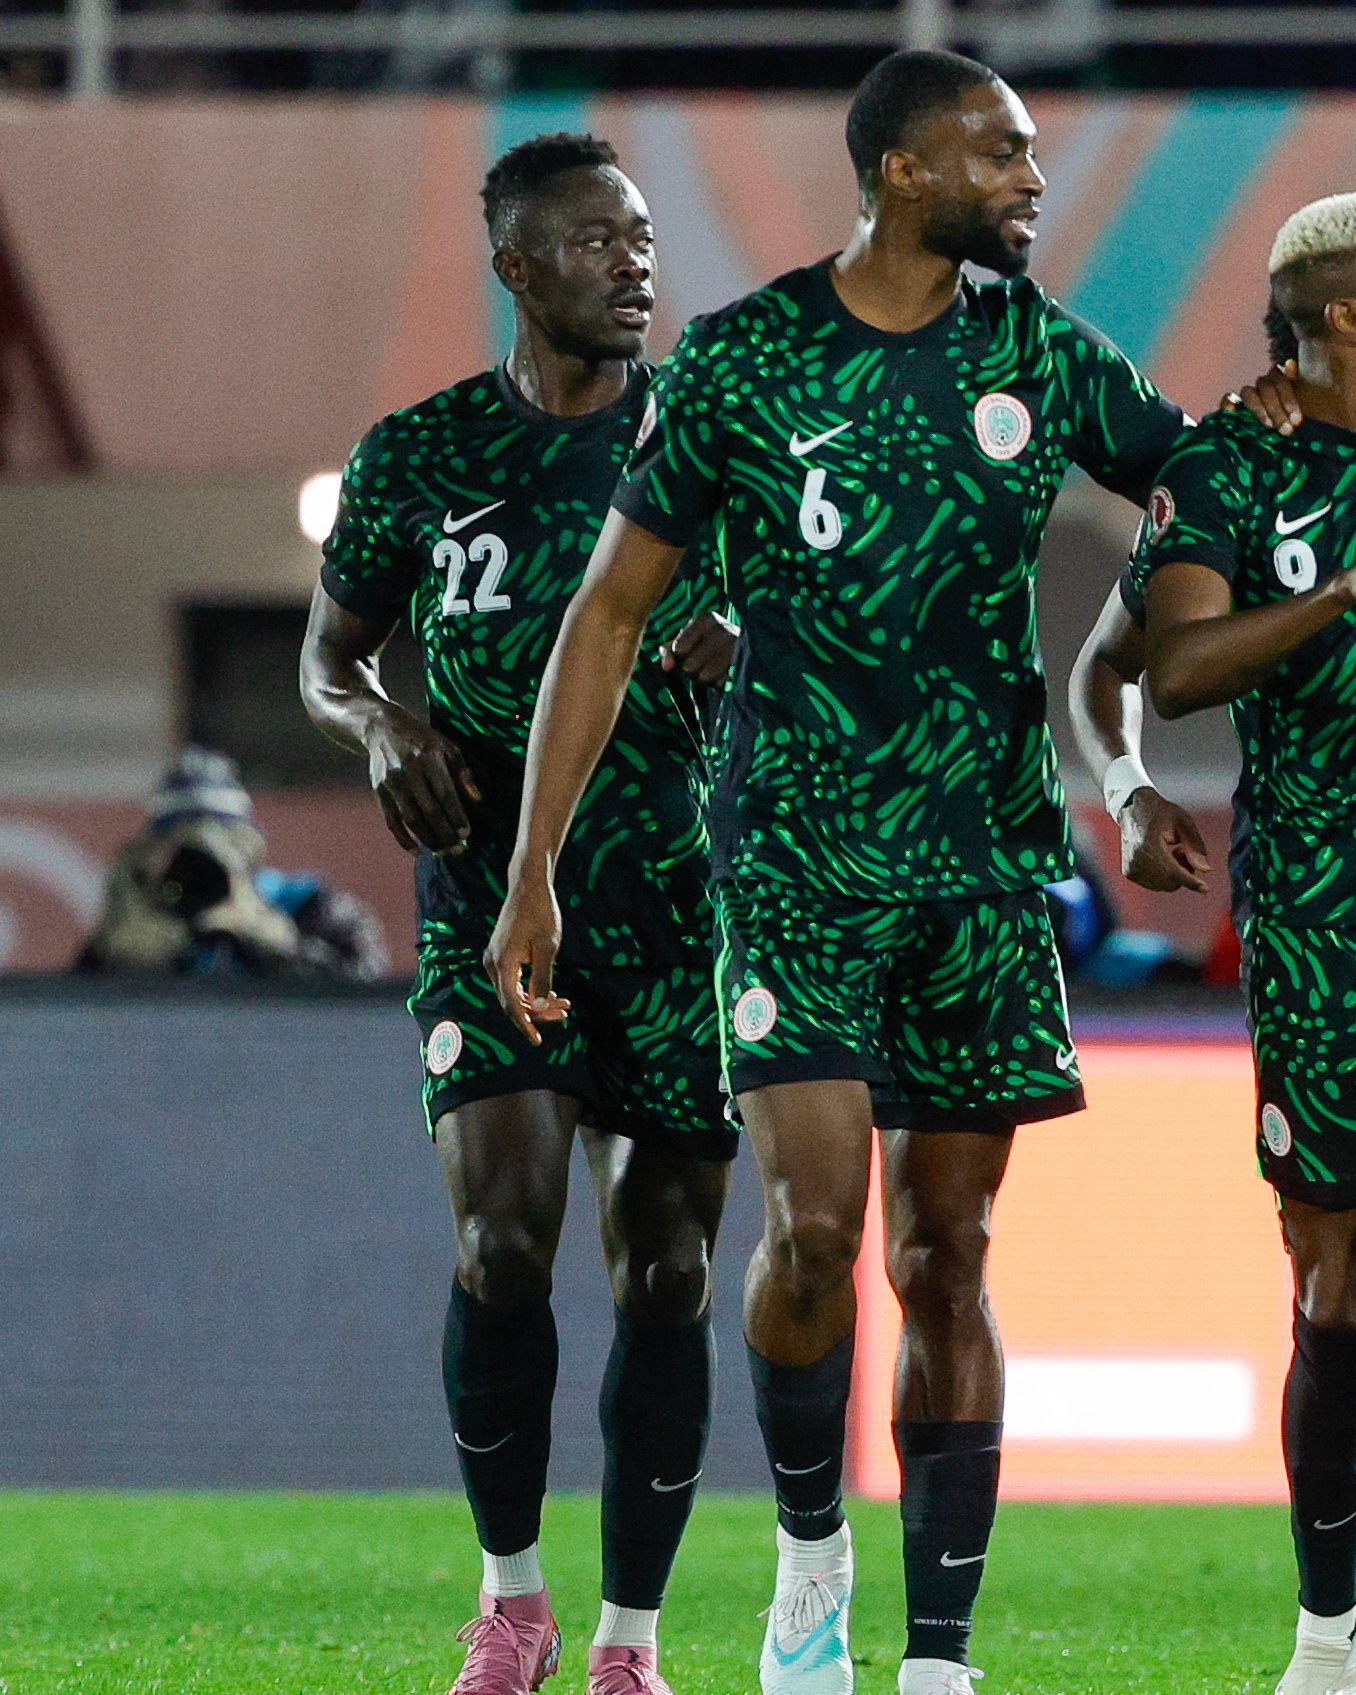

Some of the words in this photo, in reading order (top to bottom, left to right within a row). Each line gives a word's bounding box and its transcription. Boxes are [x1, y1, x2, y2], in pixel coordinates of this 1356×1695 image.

[799, 467, 843, 551] 6
[432, 533, 512, 616] 22
[1273, 538, 1318, 596] 9
